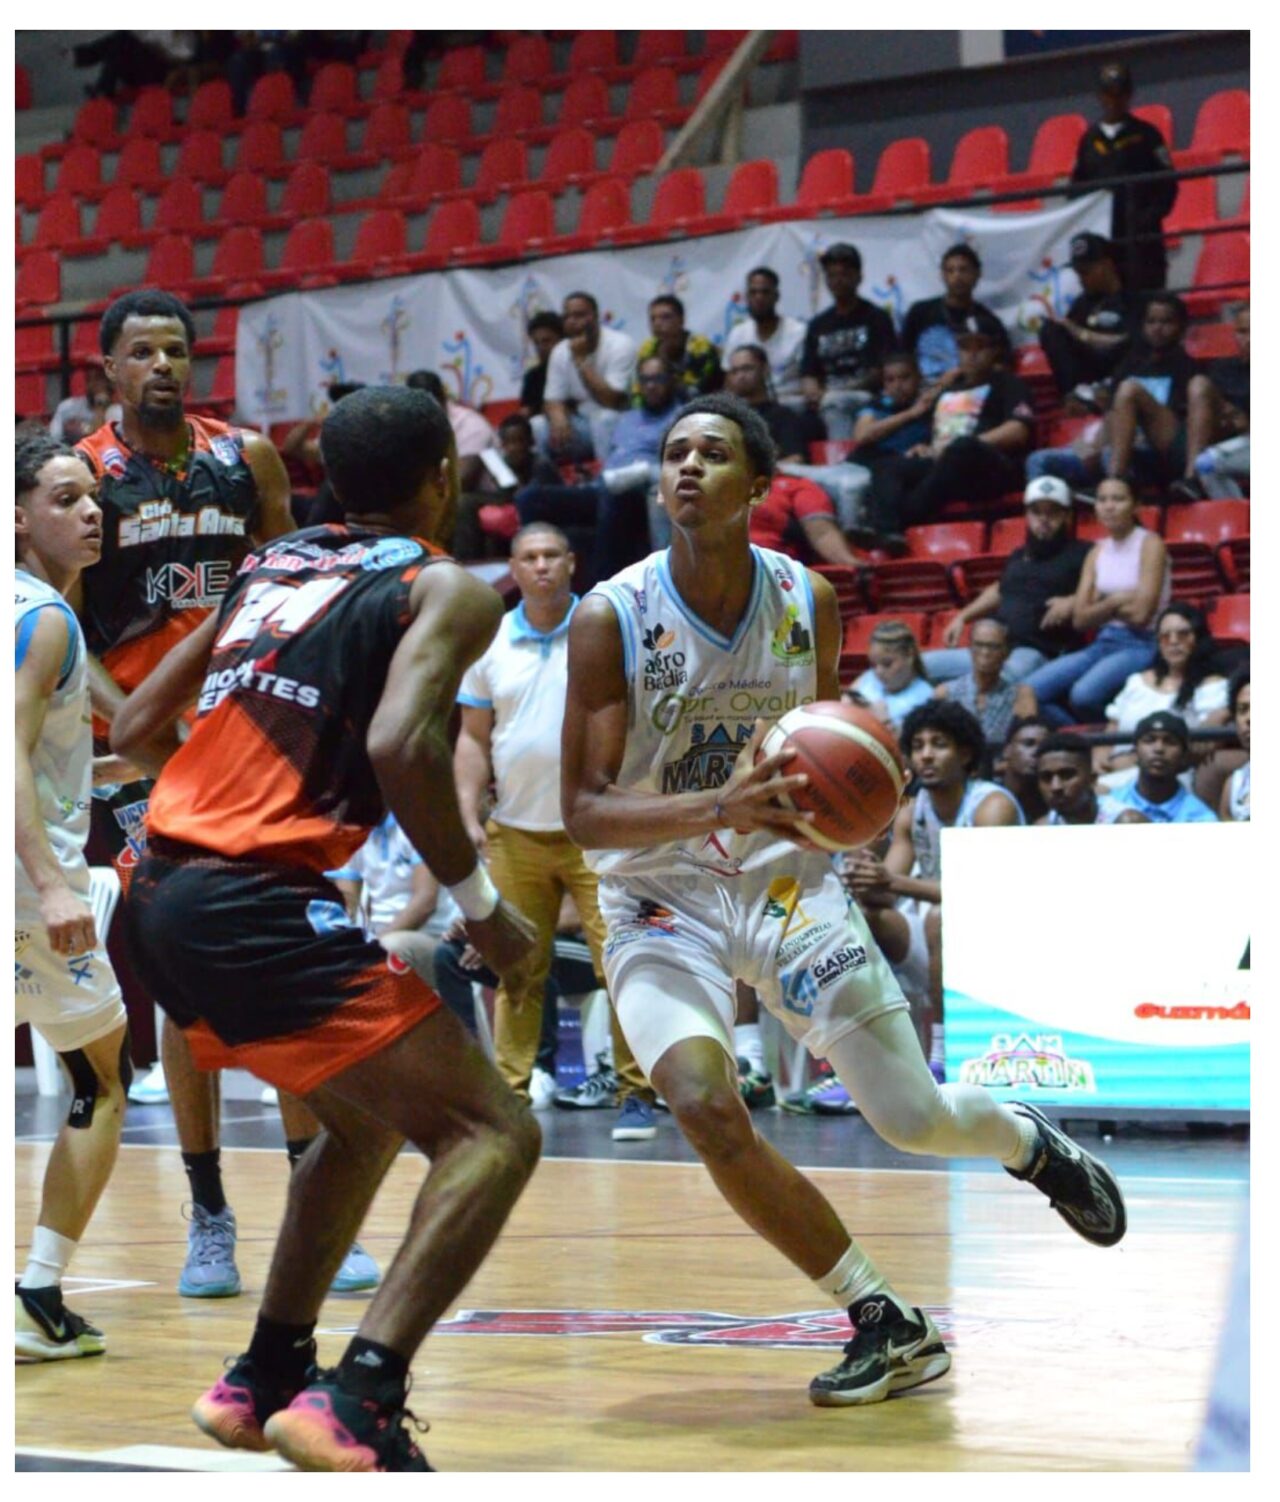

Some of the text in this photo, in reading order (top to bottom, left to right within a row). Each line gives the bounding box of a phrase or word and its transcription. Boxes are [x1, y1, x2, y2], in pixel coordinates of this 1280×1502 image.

[644, 651, 686, 678] agro
[691, 722, 756, 744] SAN
[72, 1100, 85, 1114] R
